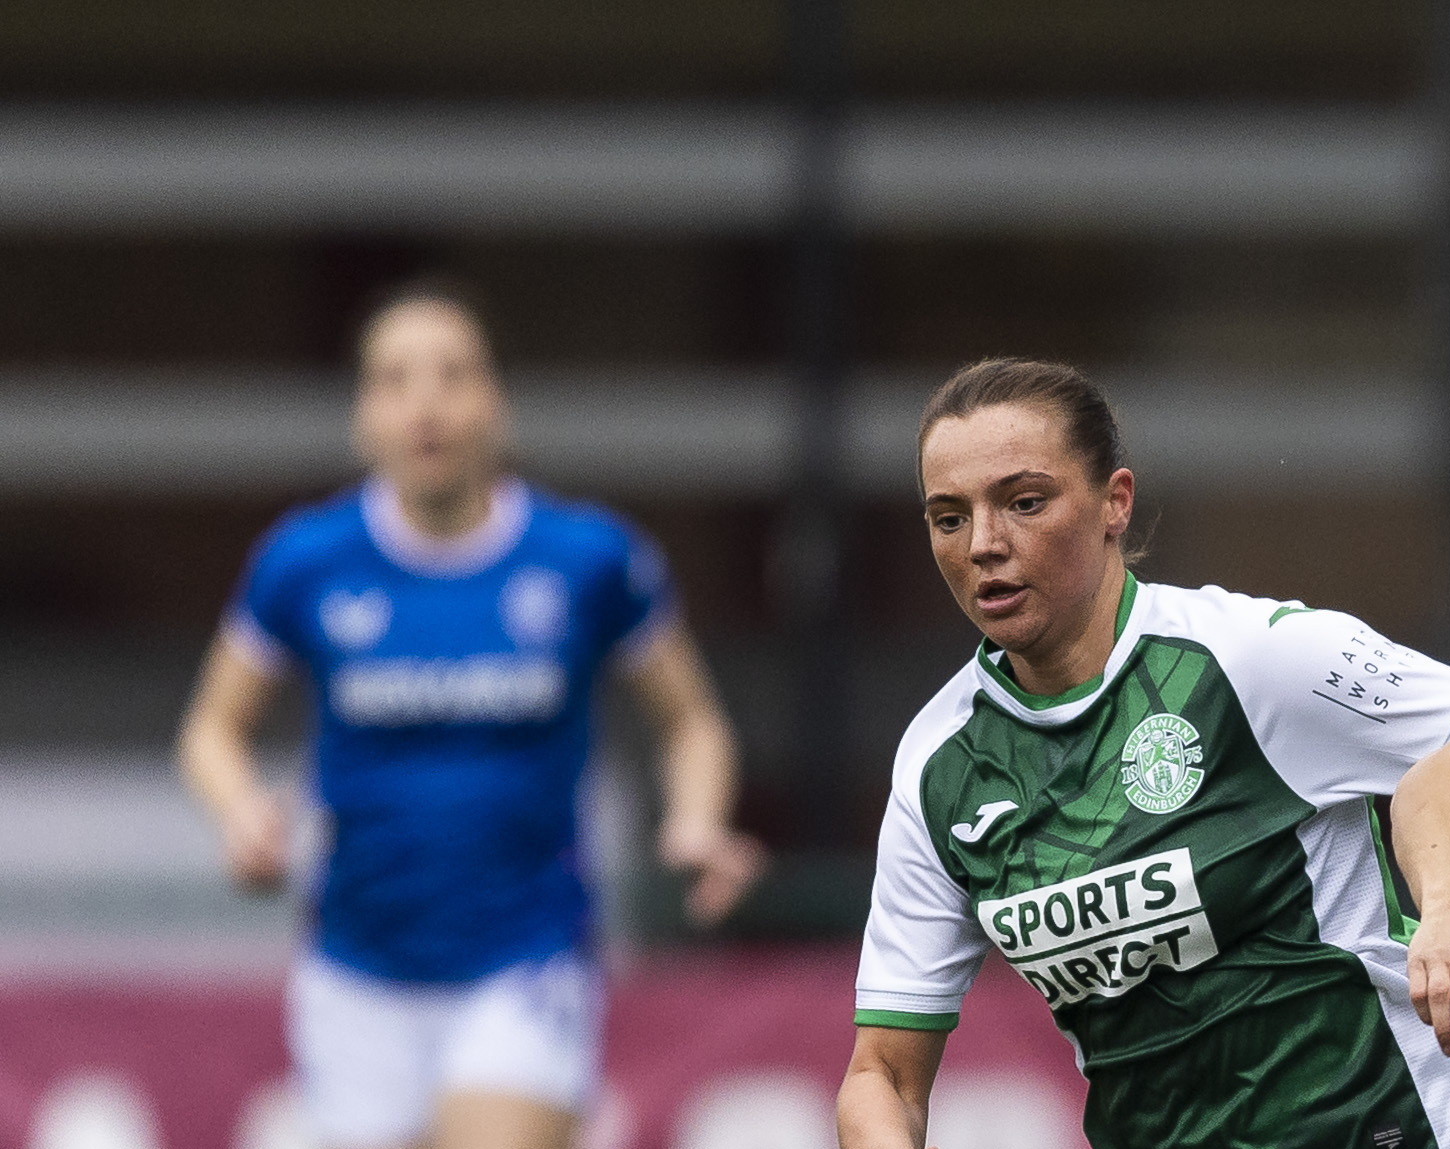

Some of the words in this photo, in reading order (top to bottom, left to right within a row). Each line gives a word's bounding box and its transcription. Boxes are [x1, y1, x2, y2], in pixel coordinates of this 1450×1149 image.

[1126, 718, 1192, 754] HIBERNIAN
[1132, 776, 1198, 810] EDINBURGH
[992, 862, 1178, 951] SPORTS
[1022, 925, 1191, 1004] DIRECT
